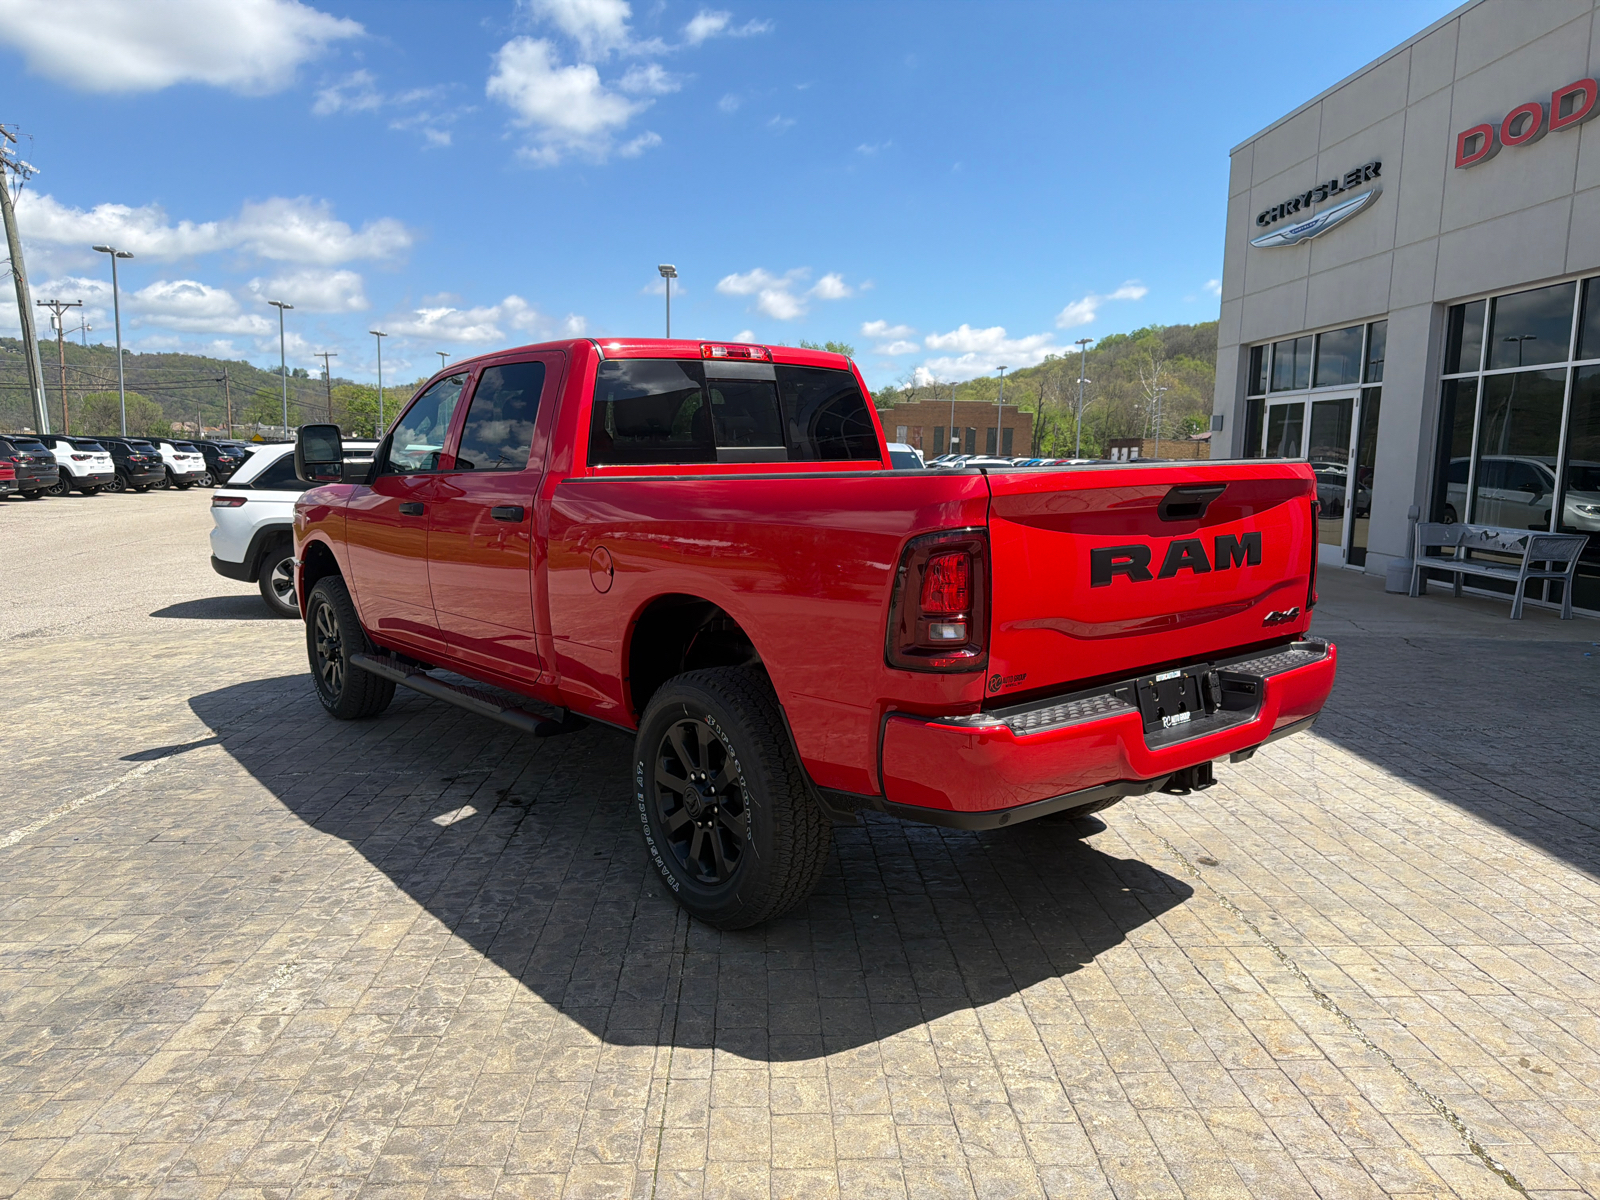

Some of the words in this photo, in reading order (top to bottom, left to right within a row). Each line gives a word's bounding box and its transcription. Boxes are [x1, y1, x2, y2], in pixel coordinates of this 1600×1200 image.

[1454, 77, 1600, 169] DOD
[1256, 161, 1382, 227] CHRYSLER
[1090, 531, 1262, 588] RAM
[1003, 675, 1013, 684] AUTO
[1014, 673, 1027, 683] GROUP
[1161, 715, 1172, 729] RC
[1180, 711, 1191, 720] GROUP
[637, 792, 680, 893] TRANSFORCE
